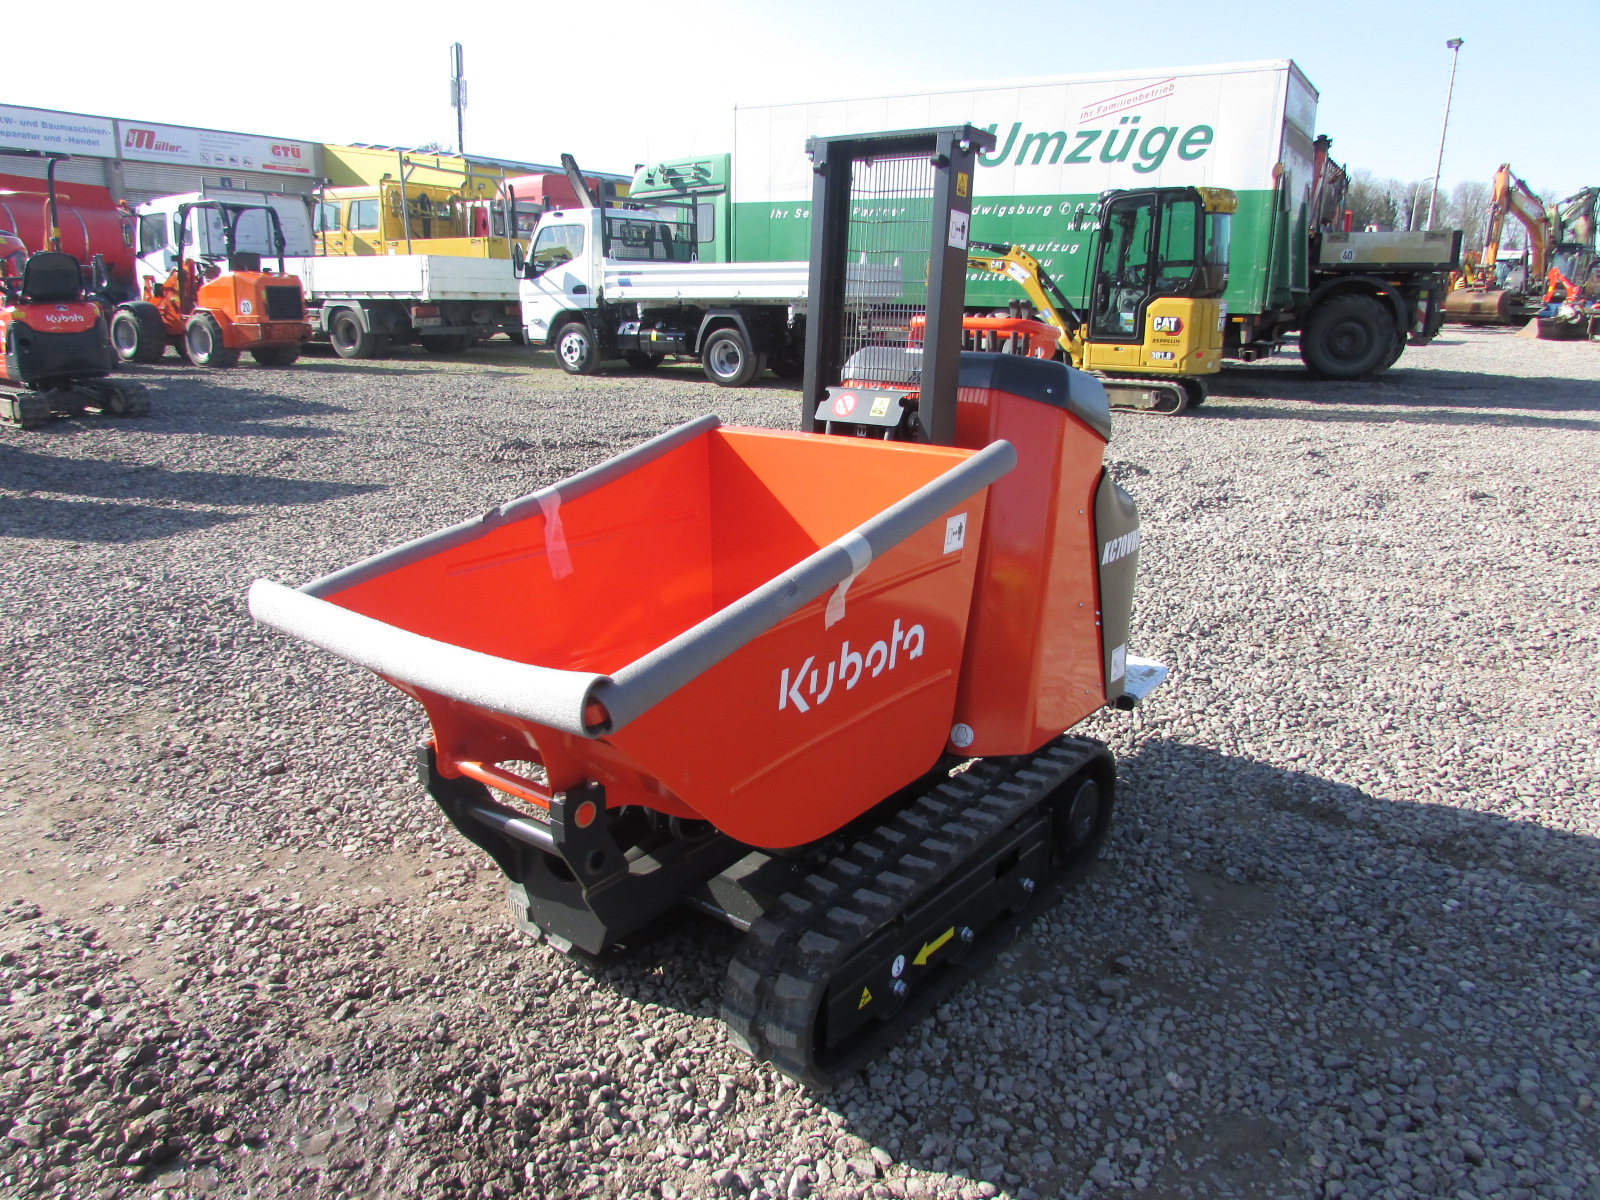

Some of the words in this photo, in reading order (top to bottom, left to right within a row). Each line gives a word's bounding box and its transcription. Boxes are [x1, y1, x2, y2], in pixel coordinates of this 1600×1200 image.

[1080, 109, 1094, 120] Ihr
[1097, 83, 1175, 114] Familienbetrieb
[20, 119, 38, 128] und
[41, 121, 112, 136] Baumaschinen-
[0, 130, 40, 139] eparatur
[44, 135, 61, 143] und
[64, 136, 100, 147] -Handel
[125, 128, 182, 153] Müller
[978, 116, 1214, 174] Umzüge
[271, 144, 301, 159] GTÜ
[770, 208, 789, 219] Ihr
[794, 207, 813, 219] Se
[971, 202, 1053, 218] dwigsburg
[1342, 250, 1353, 261] 40
[242, 301, 251, 313] 20
[46, 313, 85, 323] Kubota
[1153, 316, 1178, 332] CAT
[1151, 351, 1172, 360] 301.8
[1101, 527, 1140, 566] KC70VH
[778, 617, 925, 714] Kubota
